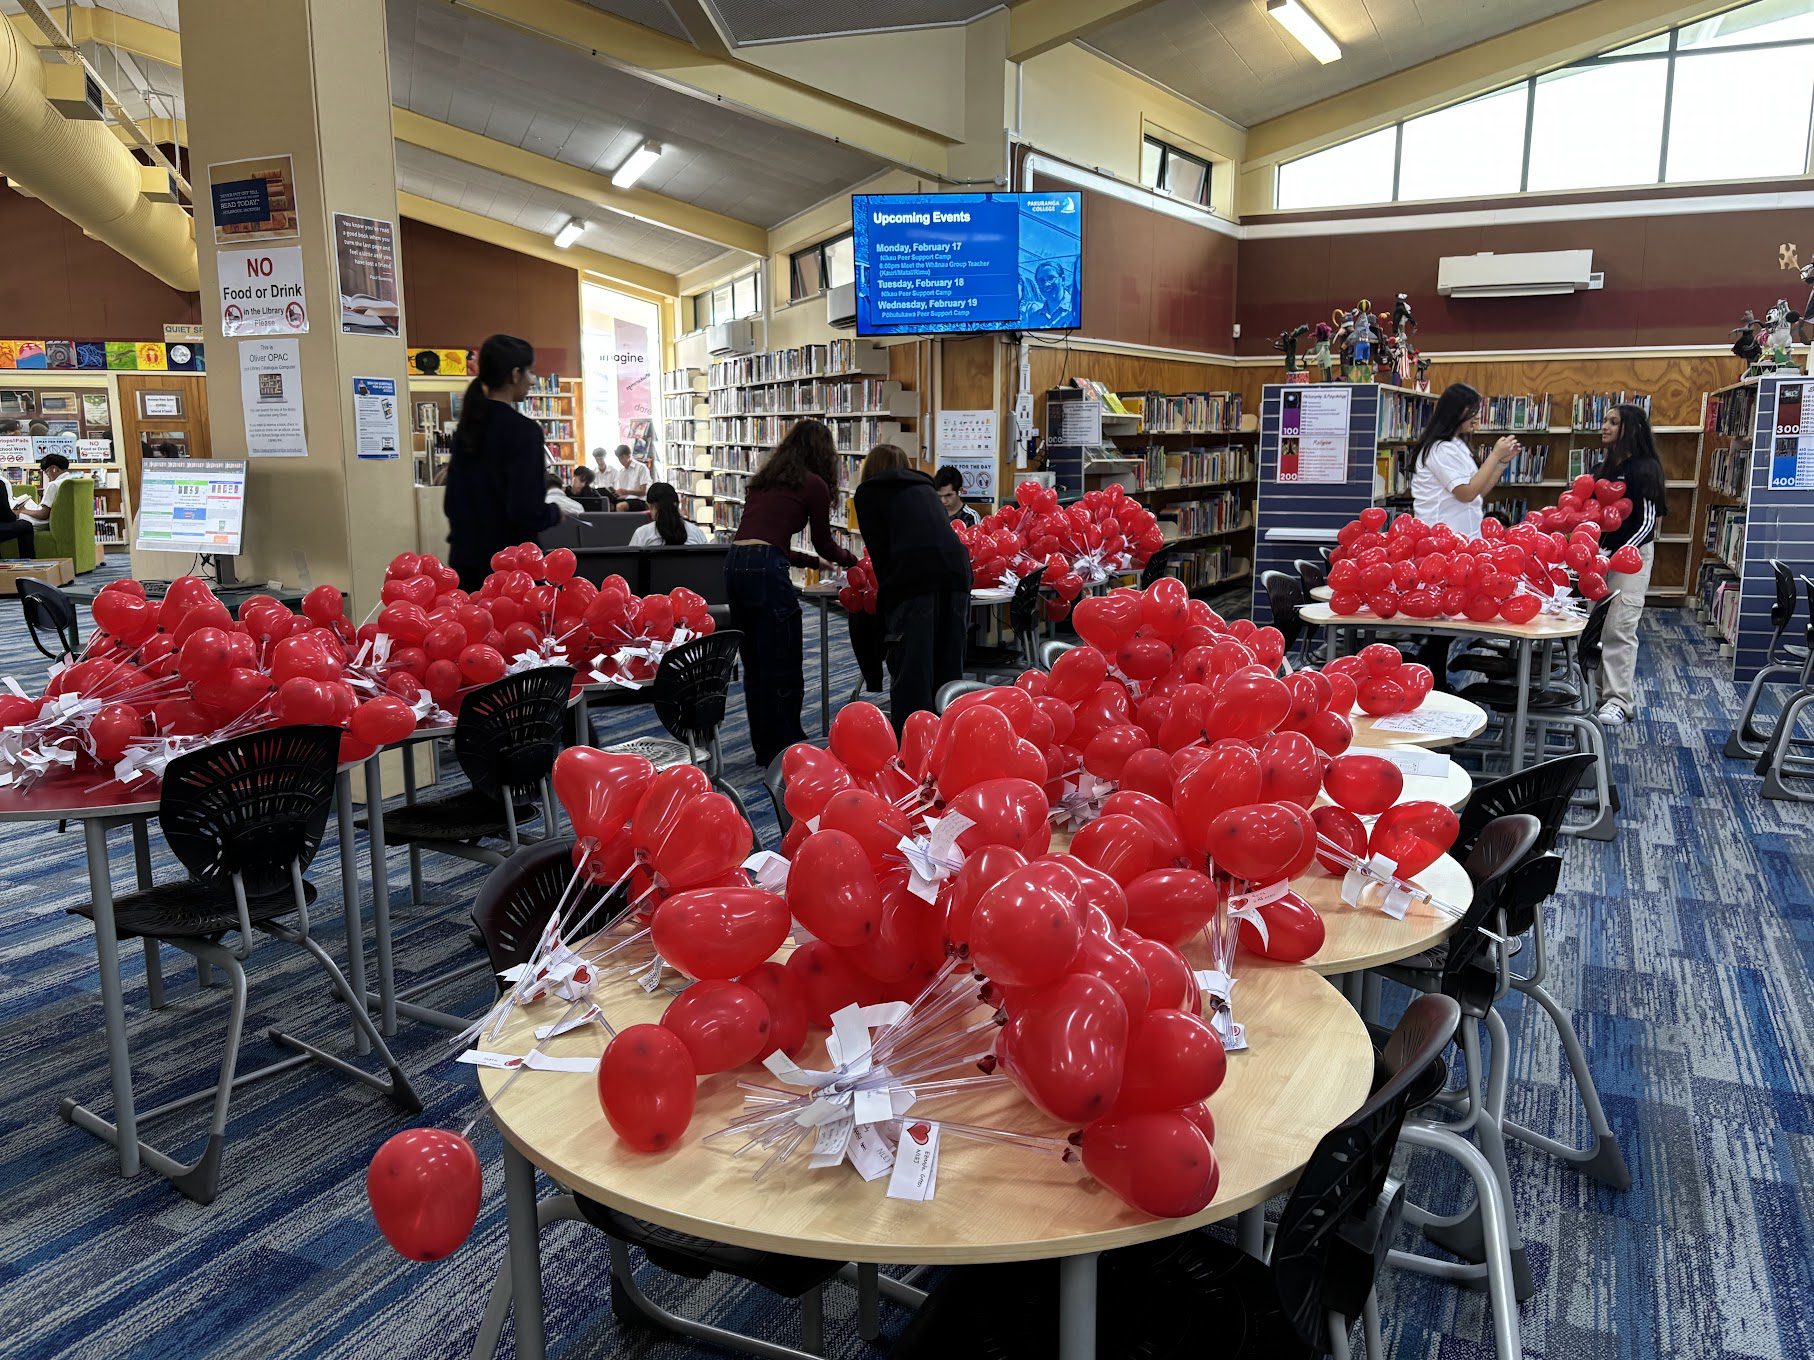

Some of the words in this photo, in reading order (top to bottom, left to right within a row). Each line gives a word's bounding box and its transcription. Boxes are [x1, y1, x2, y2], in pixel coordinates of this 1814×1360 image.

[874, 212, 930, 226] Upcoming
[932, 210, 970, 222] Events
[876, 244, 911, 253] Monday,
[912, 242, 950, 252] February
[952, 242, 962, 250] 17
[247, 257, 273, 277] NO
[877, 280, 914, 289] Tuesday,
[916, 278, 952, 288] February
[954, 278, 964, 286] 18
[223, 286, 252, 300] Food
[255, 288, 267, 298] or
[270, 284, 302, 298] Drink
[878, 300, 927, 310] Wednesday,
[929, 299, 966, 309] February
[268, 353, 288, 361] OPAC
[1776, 425, 1799, 433] 300
[1773, 478, 1794, 486] 400
